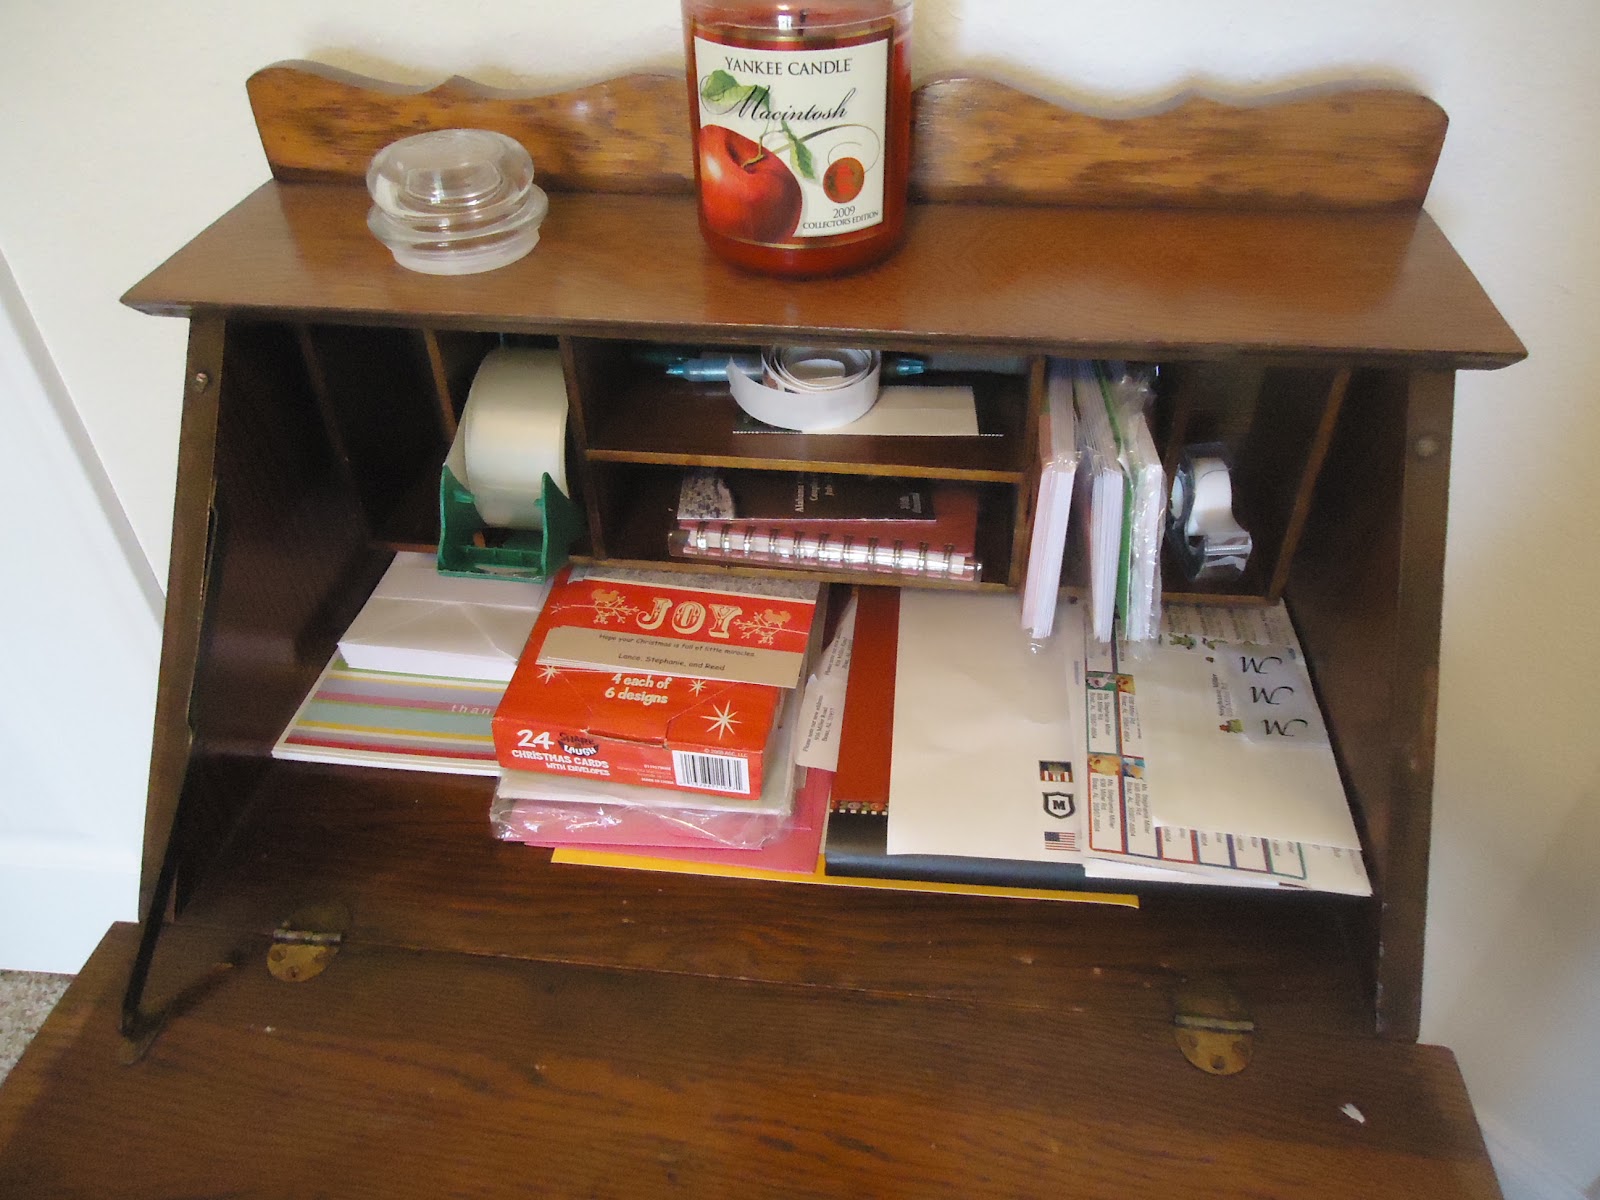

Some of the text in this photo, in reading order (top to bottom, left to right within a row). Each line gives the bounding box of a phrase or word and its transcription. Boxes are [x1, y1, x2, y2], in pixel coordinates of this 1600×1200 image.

[725, 57, 852, 75] YANKEE CANDLE
[734, 84, 856, 121] Macintosh
[803, 210, 879, 230] COLLECTORS EDITION
[833, 206, 856, 219] 2009
[636, 597, 742, 638] JOY
[599, 633, 616, 641] Hope
[636, 638, 671, 648] Christmas
[705, 646, 722, 654] little
[689, 661, 703, 669] and
[705, 664, 726, 672] Reed
[612, 673, 672, 689] 4 each of
[605, 688, 668, 706] 6 designs
[452, 704, 490, 714] than
[517, 729, 554, 750] 24
[512, 750, 609, 768] CHRISTMAS CARDS
[564, 744, 597, 756] LAUGH
[546, 762, 566, 770] WITH
[568, 764, 610, 776] ENVELOPES
[1052, 800, 1066, 810] M
